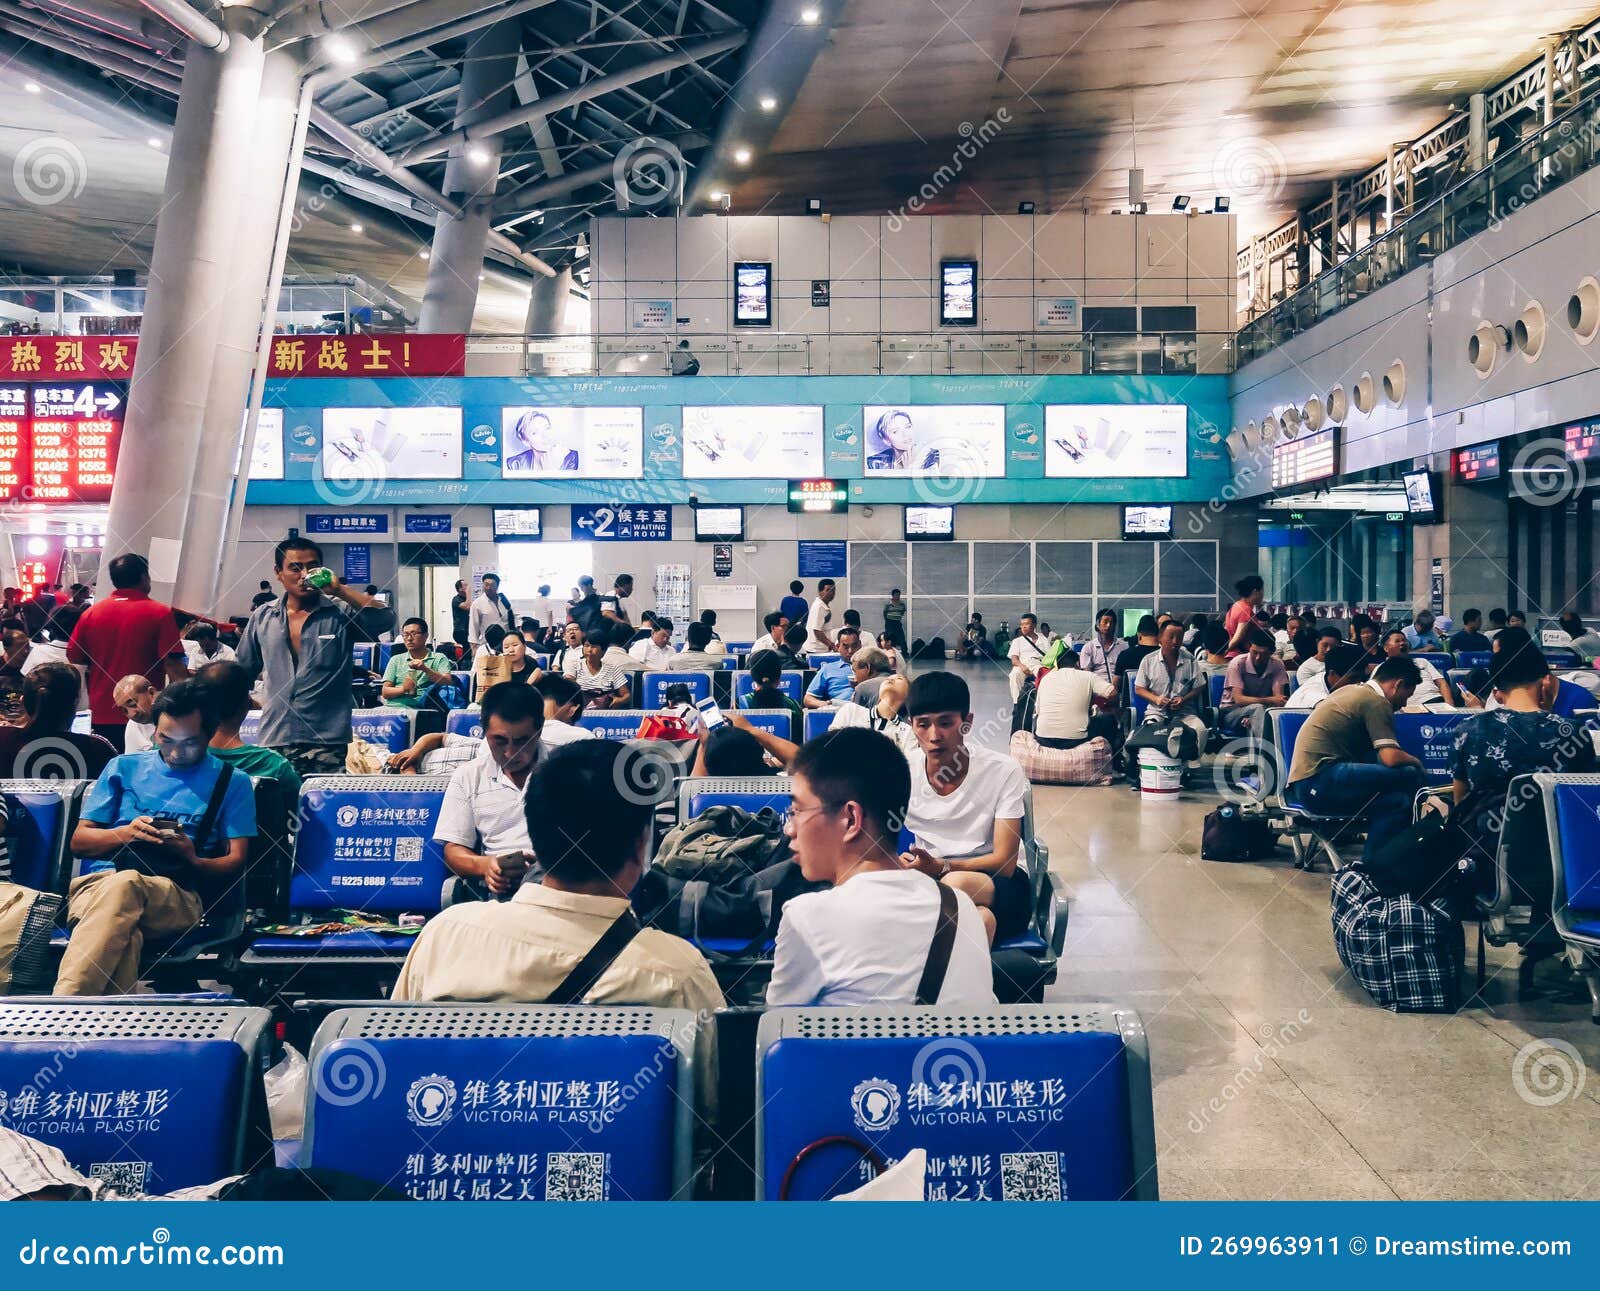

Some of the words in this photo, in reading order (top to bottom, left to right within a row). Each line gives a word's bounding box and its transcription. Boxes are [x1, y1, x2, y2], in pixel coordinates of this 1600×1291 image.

[10, 340, 130, 373] 热烈欢
[74, 385, 98, 418] 4
[803, 482, 834, 492] 21:33
[594, 508, 615, 537] 2
[617, 509, 667, 523] 候车室
[633, 523, 666, 531] WAITING
[361, 808, 430, 820] 维多利亚整形
[12, 1088, 168, 1120] 维多利亚整形
[462, 1079, 621, 1109] 维多利亚整形
[906, 1078, 1067, 1111] 维多利亚整形
[12, 1121, 85, 1134] VICTORIA
[95, 1119, 160, 1133] PLASTIC
[463, 1110, 539, 1123] VICTORIA
[548, 1110, 615, 1123] PLASTIC
[910, 1112, 987, 1126] VICTORIA
[997, 1108, 1065, 1123] PLASTIC
[405, 1152, 538, 1177] 维多利亚整形
[404, 1178, 536, 1201] 定制专属之美
